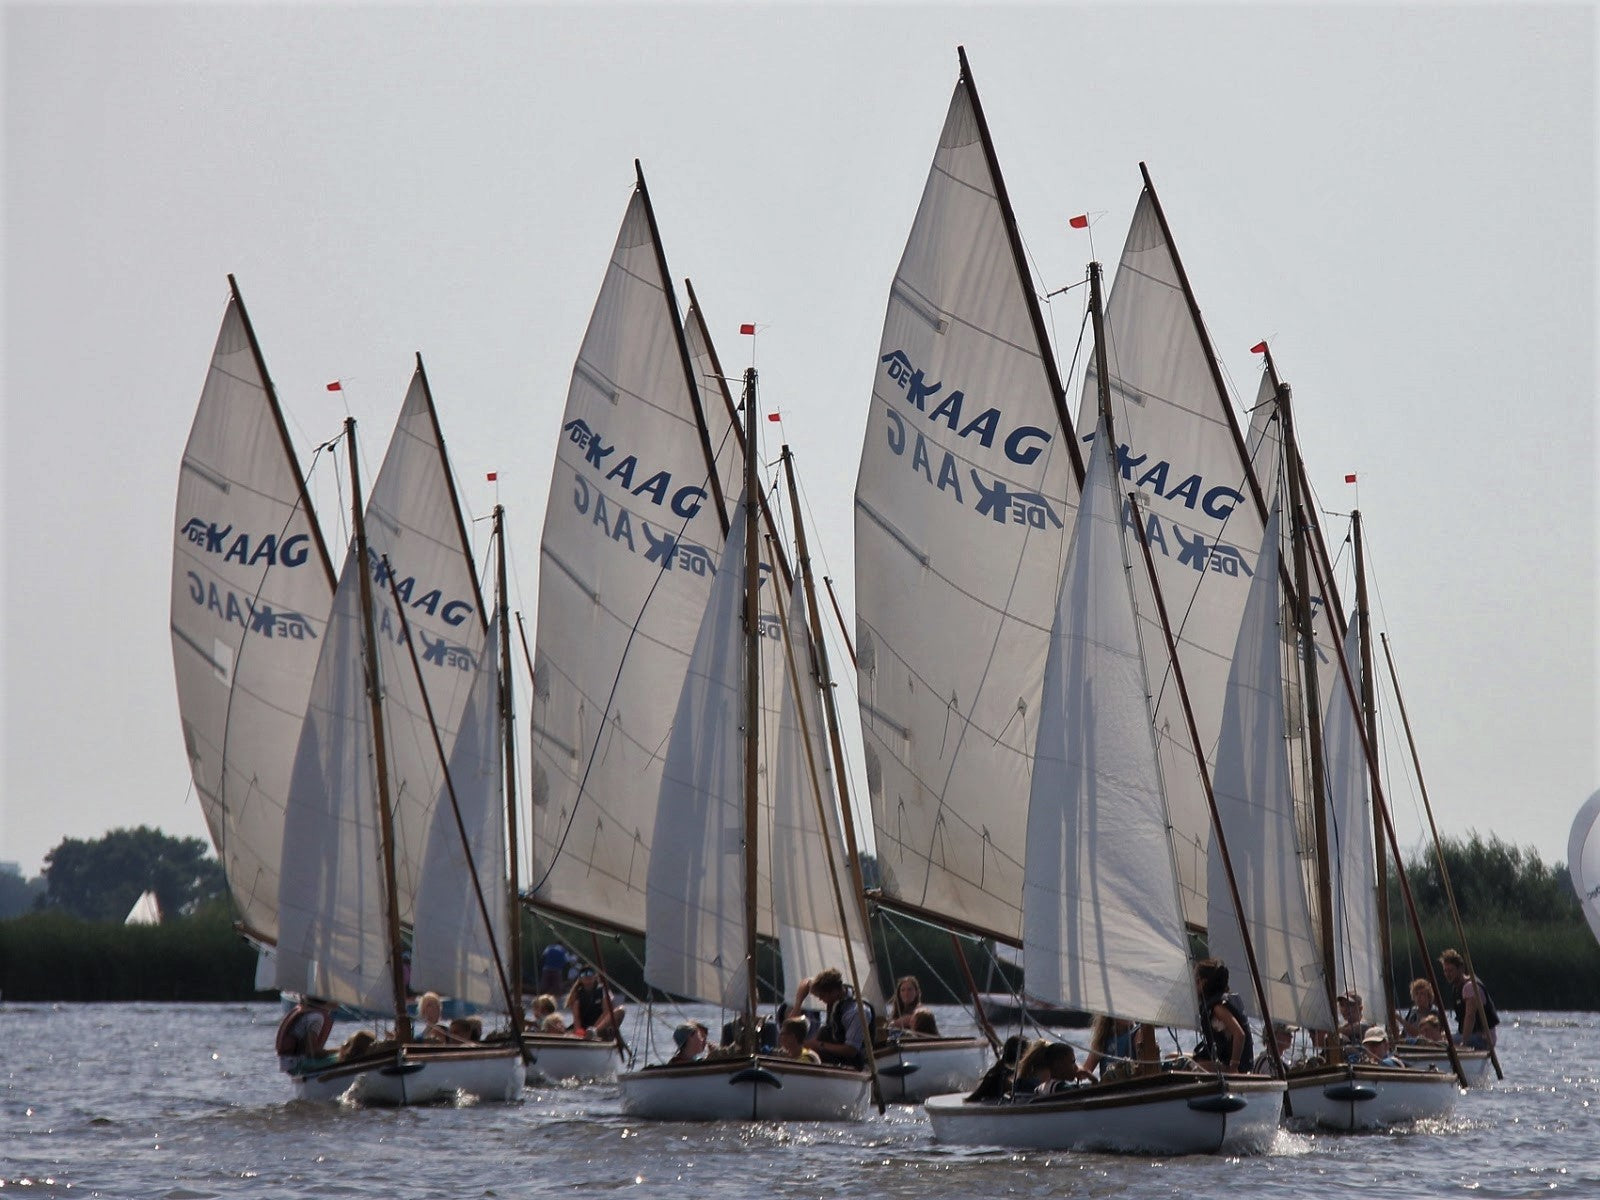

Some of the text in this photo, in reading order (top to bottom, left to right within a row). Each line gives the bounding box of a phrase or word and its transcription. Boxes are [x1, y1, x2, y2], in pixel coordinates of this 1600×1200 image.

[887, 359, 1052, 465] DE KAAG
[569, 427, 708, 519] DE KAAG
[1116, 443, 1245, 520] KAAG
[188, 523, 310, 568] DE KAAG
